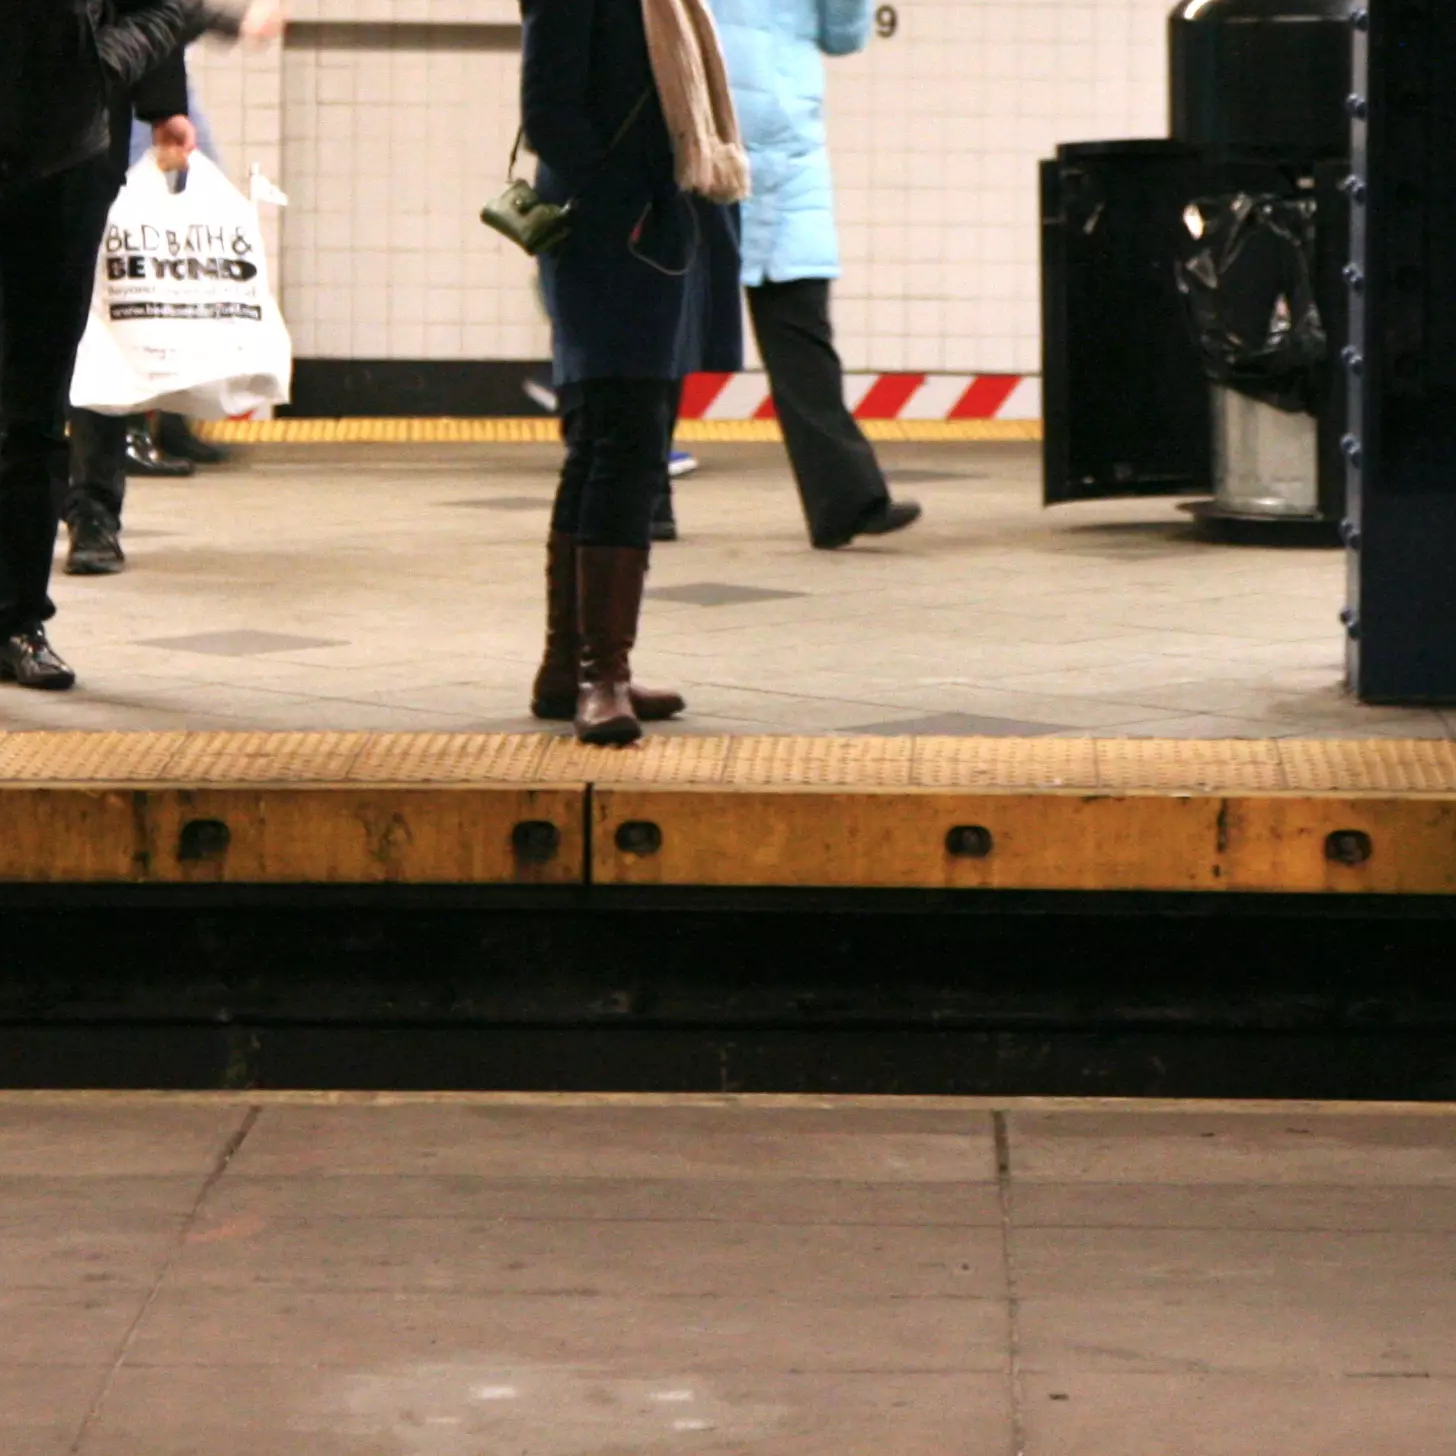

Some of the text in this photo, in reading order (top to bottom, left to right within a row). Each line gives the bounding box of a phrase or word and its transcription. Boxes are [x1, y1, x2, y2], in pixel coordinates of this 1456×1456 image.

[106, 223, 253, 256] BED BATH &
[106, 255, 257, 282] BEYOND
